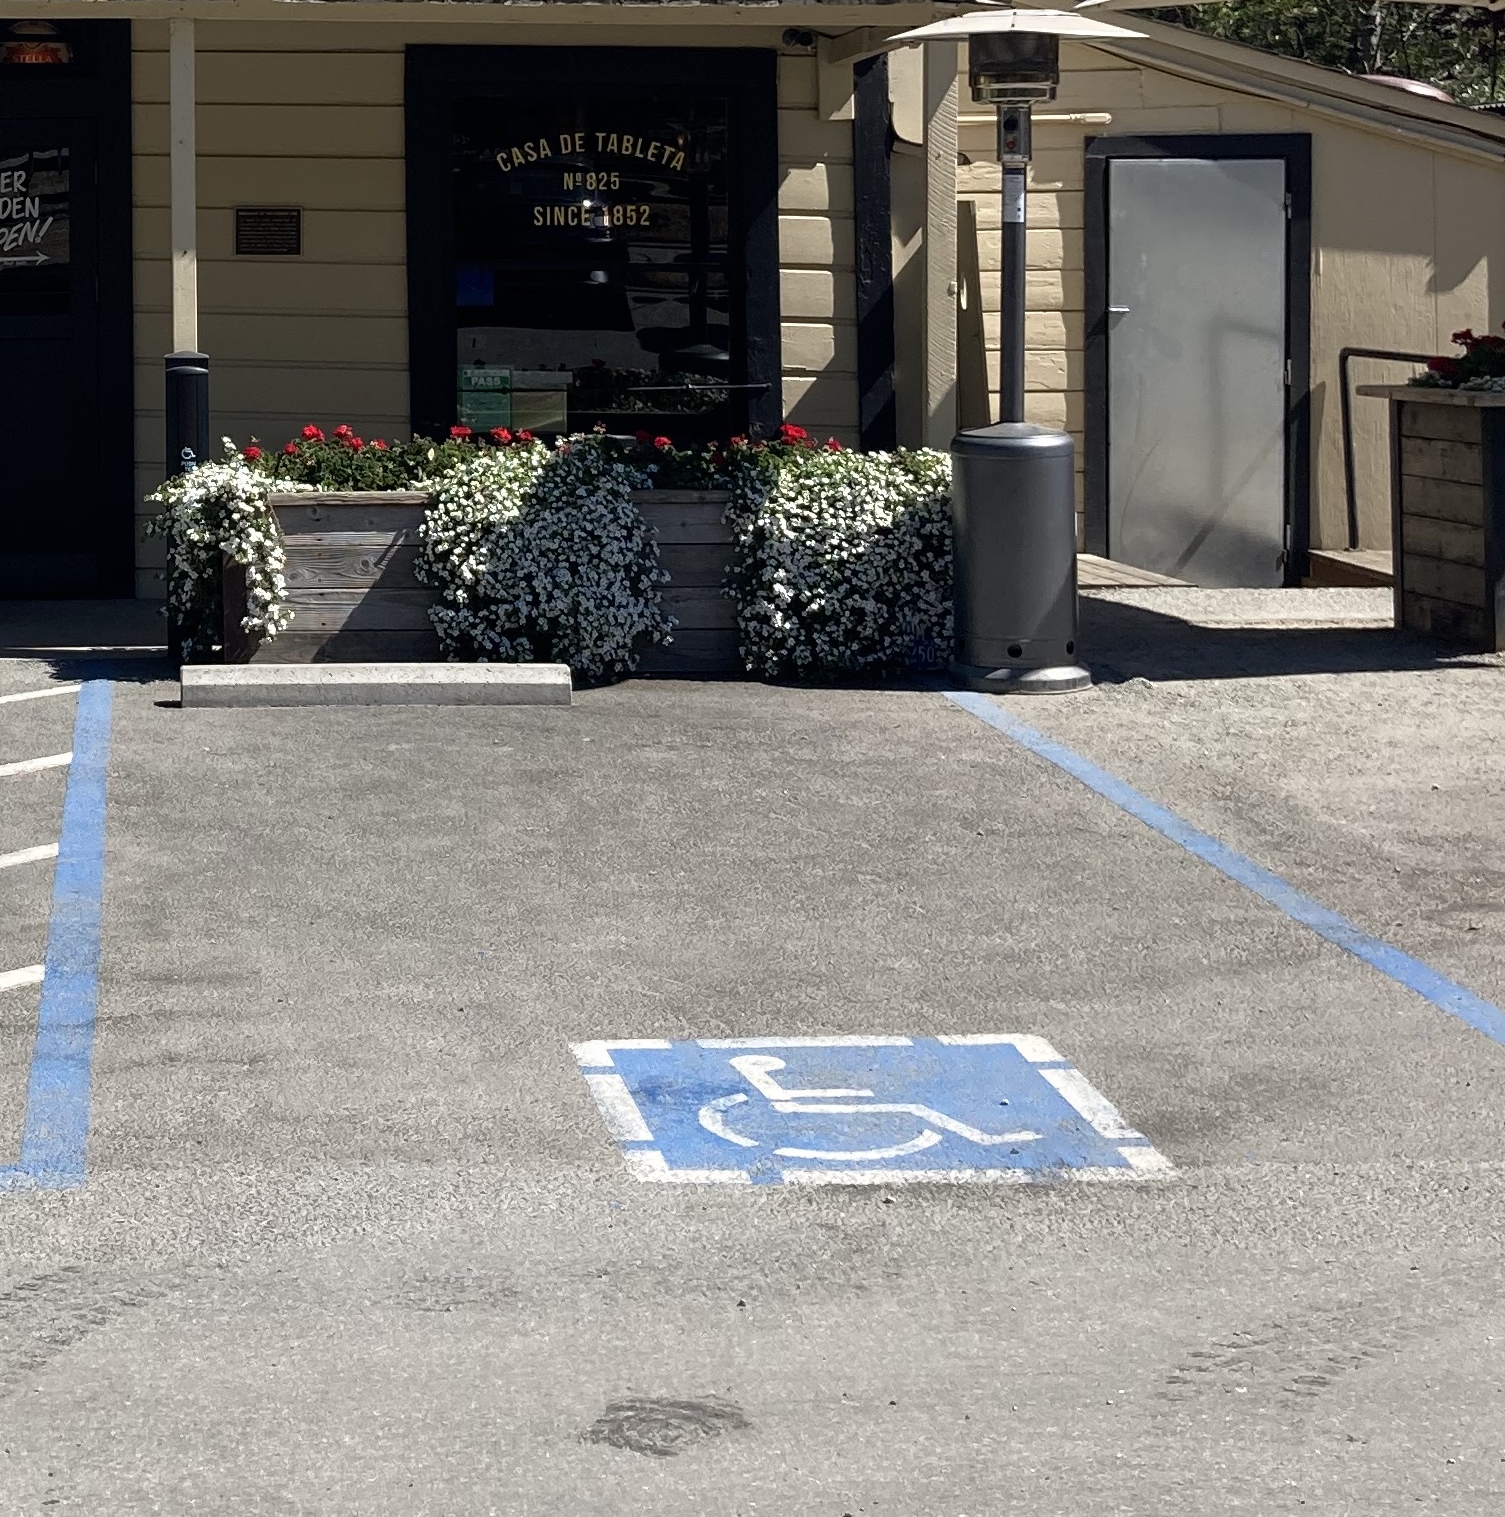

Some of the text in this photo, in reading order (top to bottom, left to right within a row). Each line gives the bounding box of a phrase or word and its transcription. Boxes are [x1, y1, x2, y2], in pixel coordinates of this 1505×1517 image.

[12, 55, 53, 64] STELLA
[496, 132, 685, 172] CASA DE TABLETA
[533, 205, 651, 226] SINCE 1852
[471, 376, 501, 386] PASS
